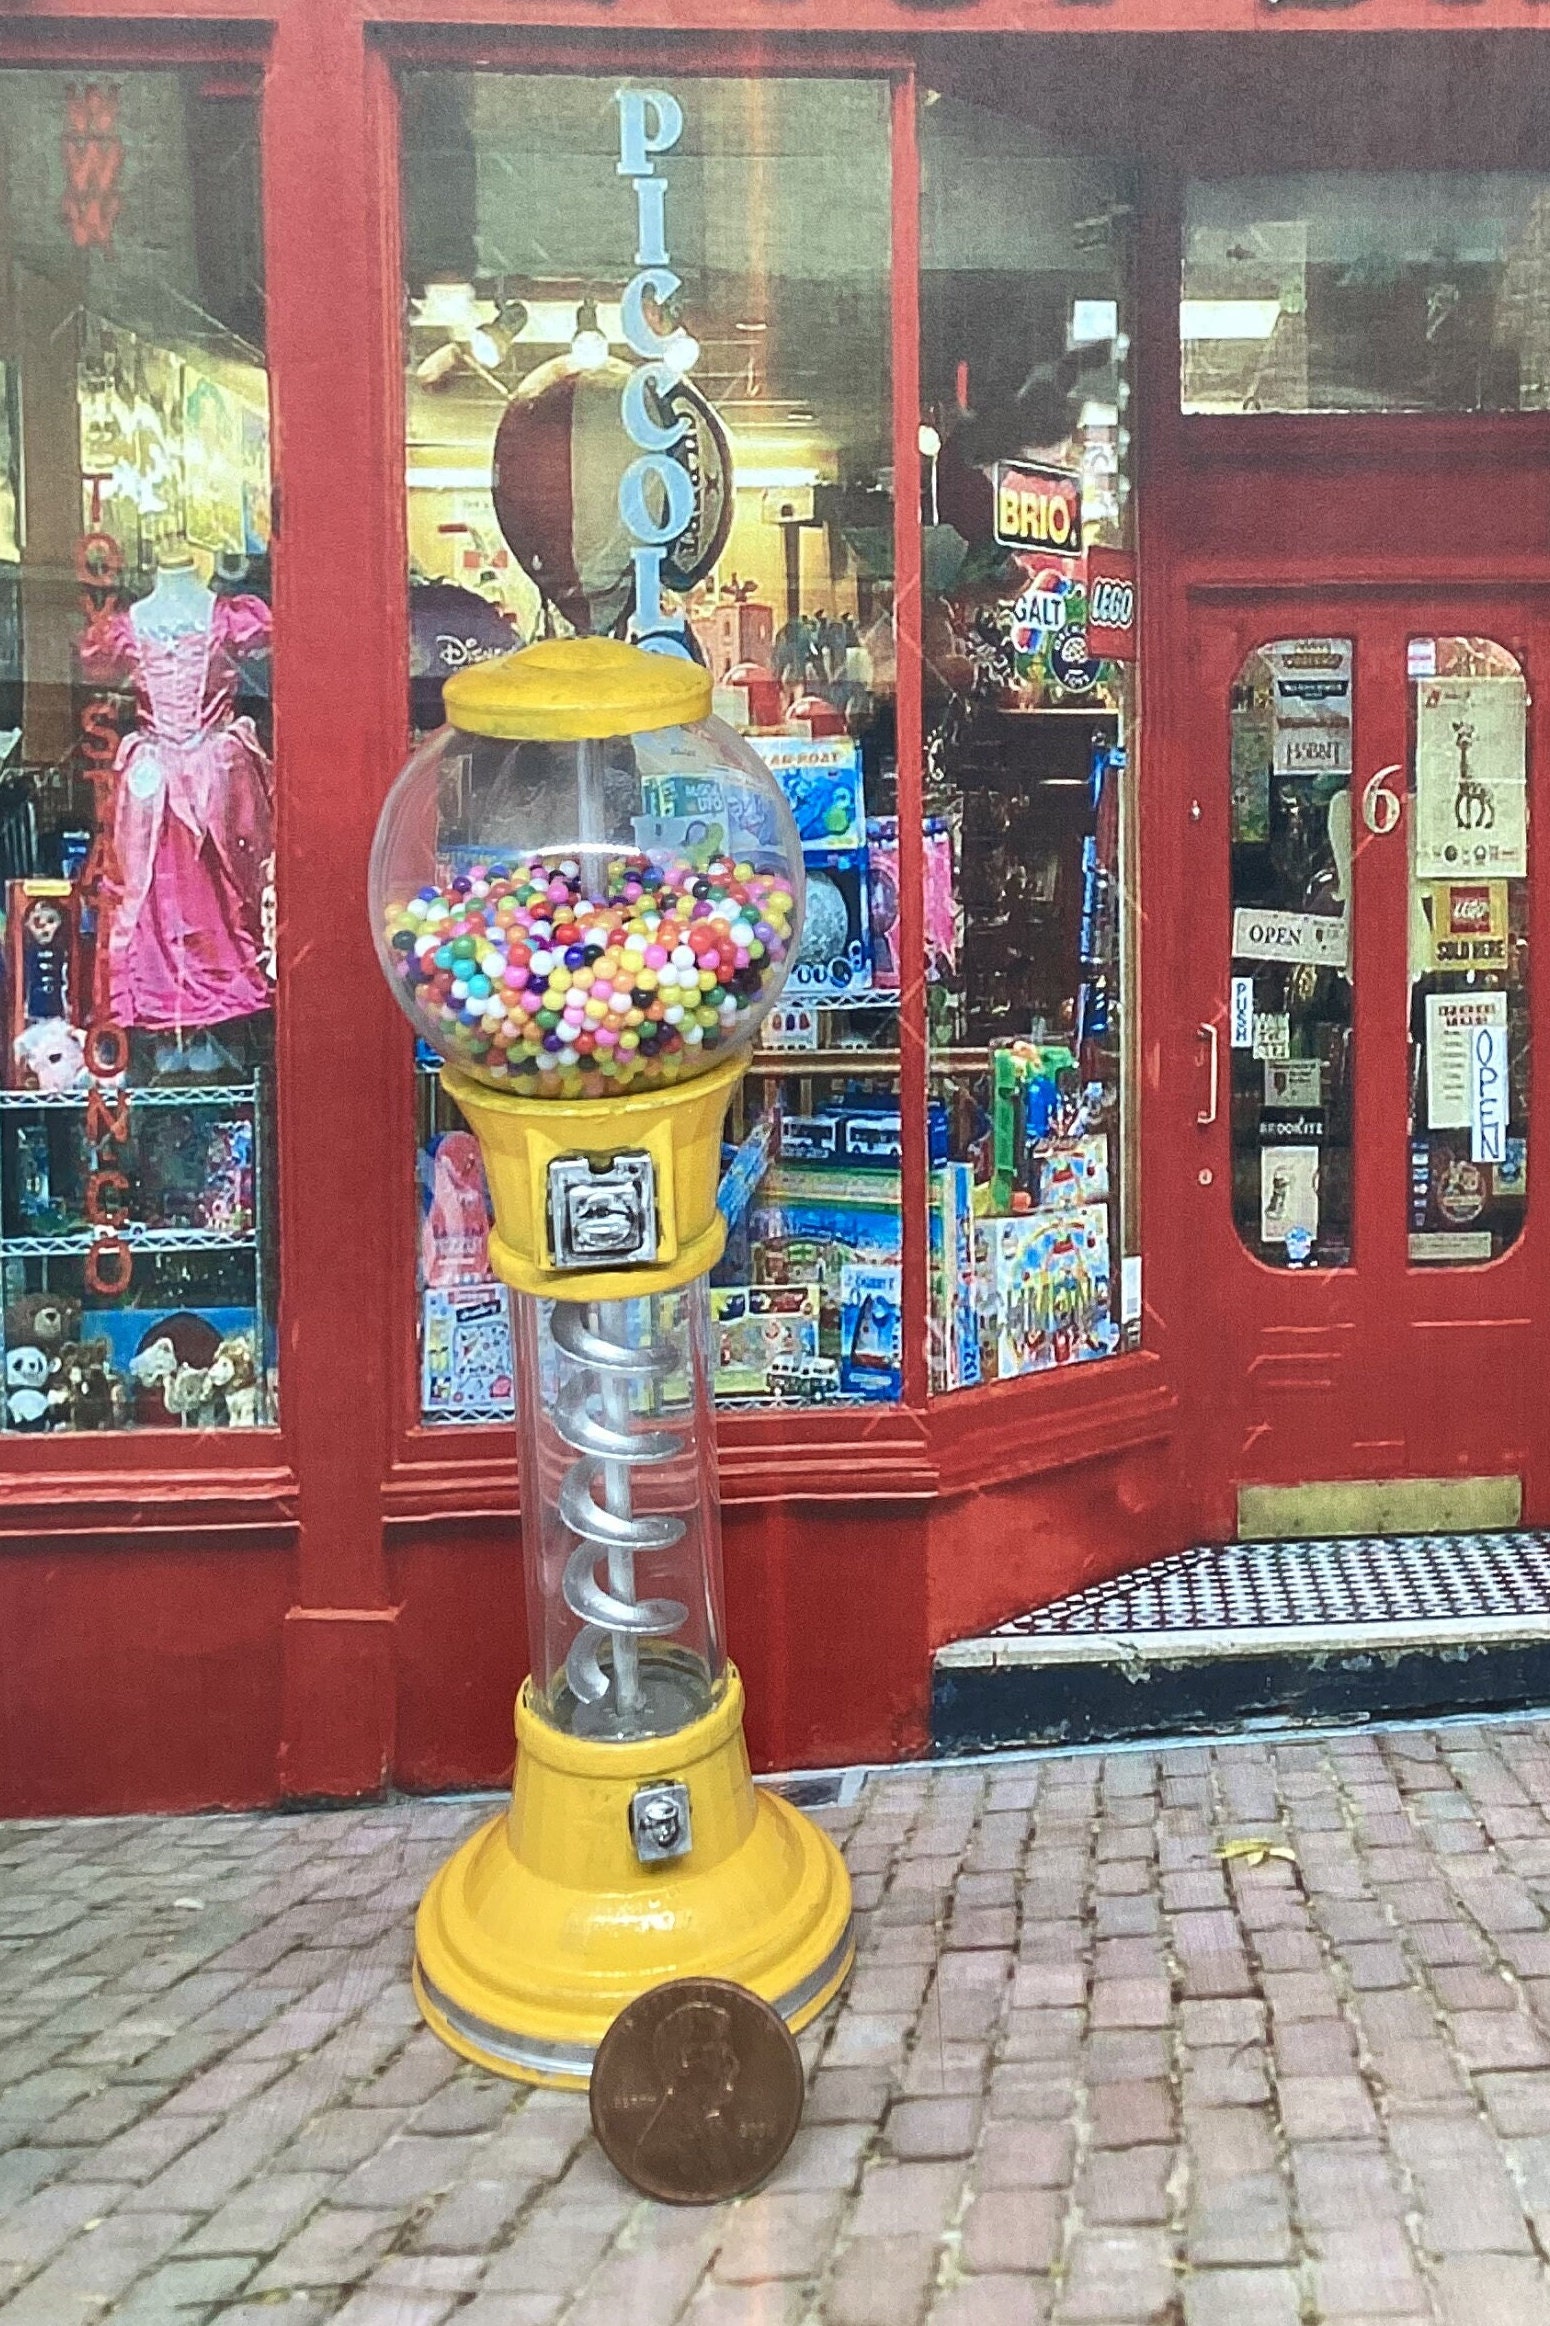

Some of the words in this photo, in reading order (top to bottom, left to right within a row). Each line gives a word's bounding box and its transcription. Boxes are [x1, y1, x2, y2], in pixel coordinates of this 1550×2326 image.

[1000, 487, 1070, 544] BRIO
[1014, 597, 1061, 626] GALT
[1093, 582, 1133, 625] LEGO
[1363, 764, 1402, 834] 6
[1249, 923, 1302, 946] OPEN
[1476, 1029, 1500, 1159] OPEN
